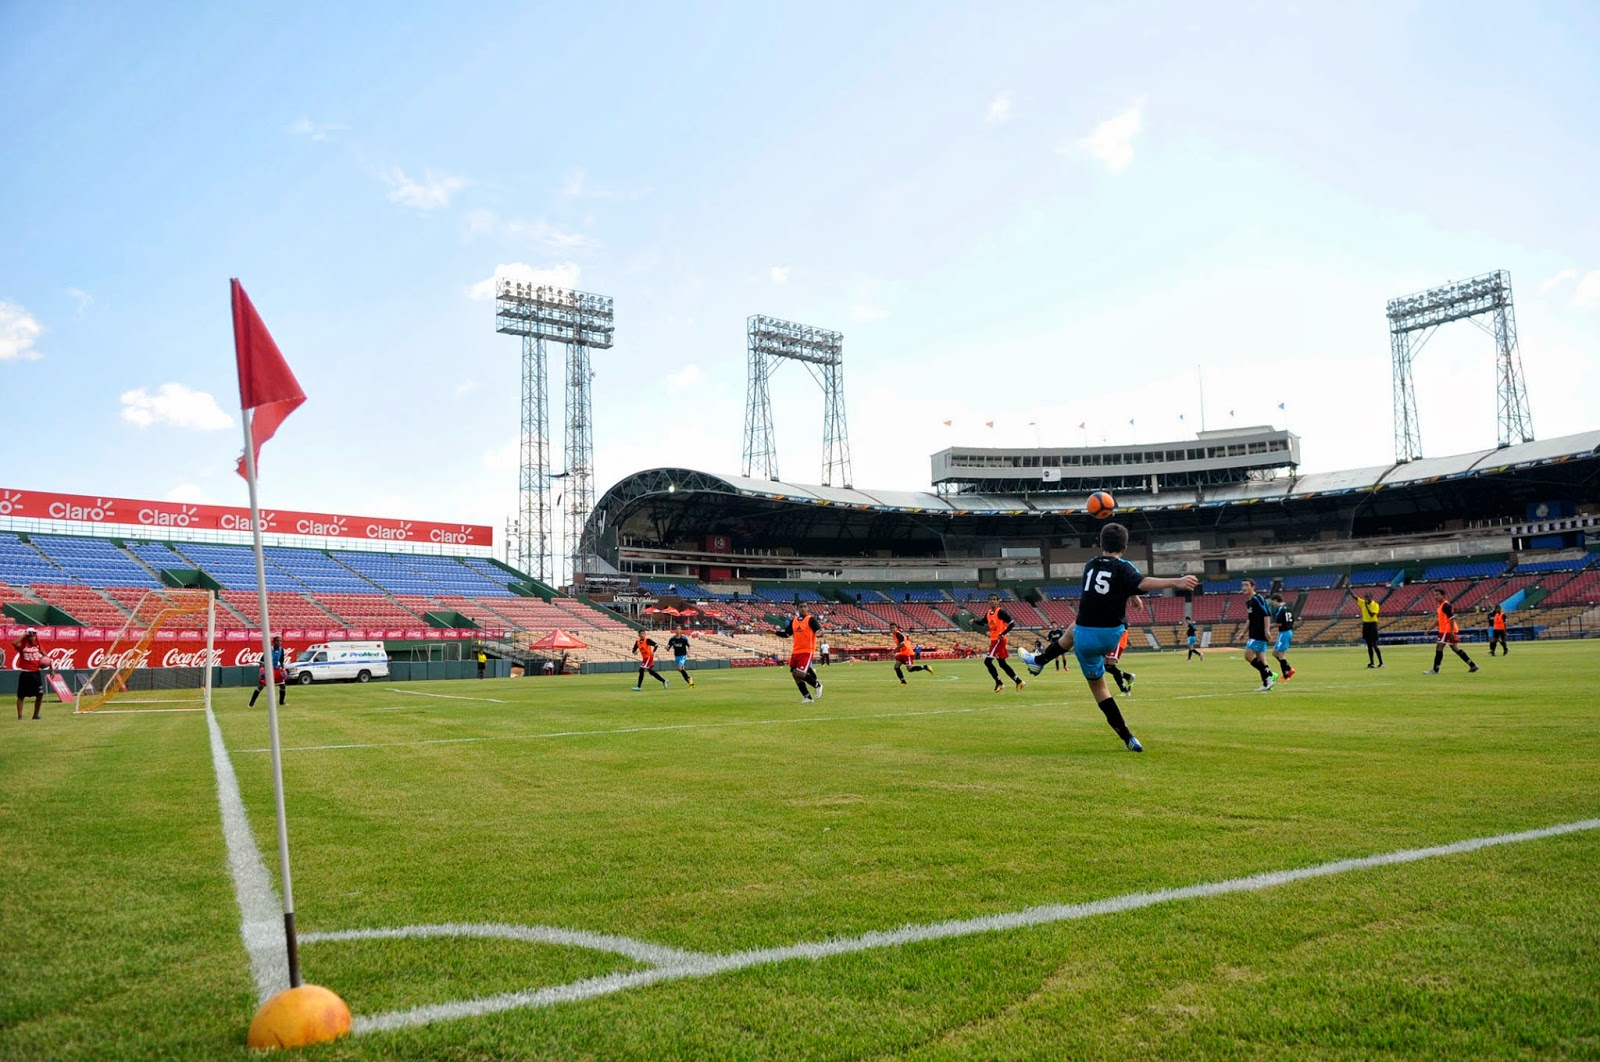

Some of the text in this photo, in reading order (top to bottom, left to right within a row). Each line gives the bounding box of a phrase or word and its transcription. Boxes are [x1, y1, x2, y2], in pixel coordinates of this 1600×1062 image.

[49, 502, 104, 521] Claro
[138, 508, 190, 527] Claro
[296, 519, 339, 536] Claro
[366, 524, 407, 540] Claro
[430, 529, 467, 544] Claro
[1084, 568, 1112, 595] 15
[87, 648, 152, 669] Coa-Cola
